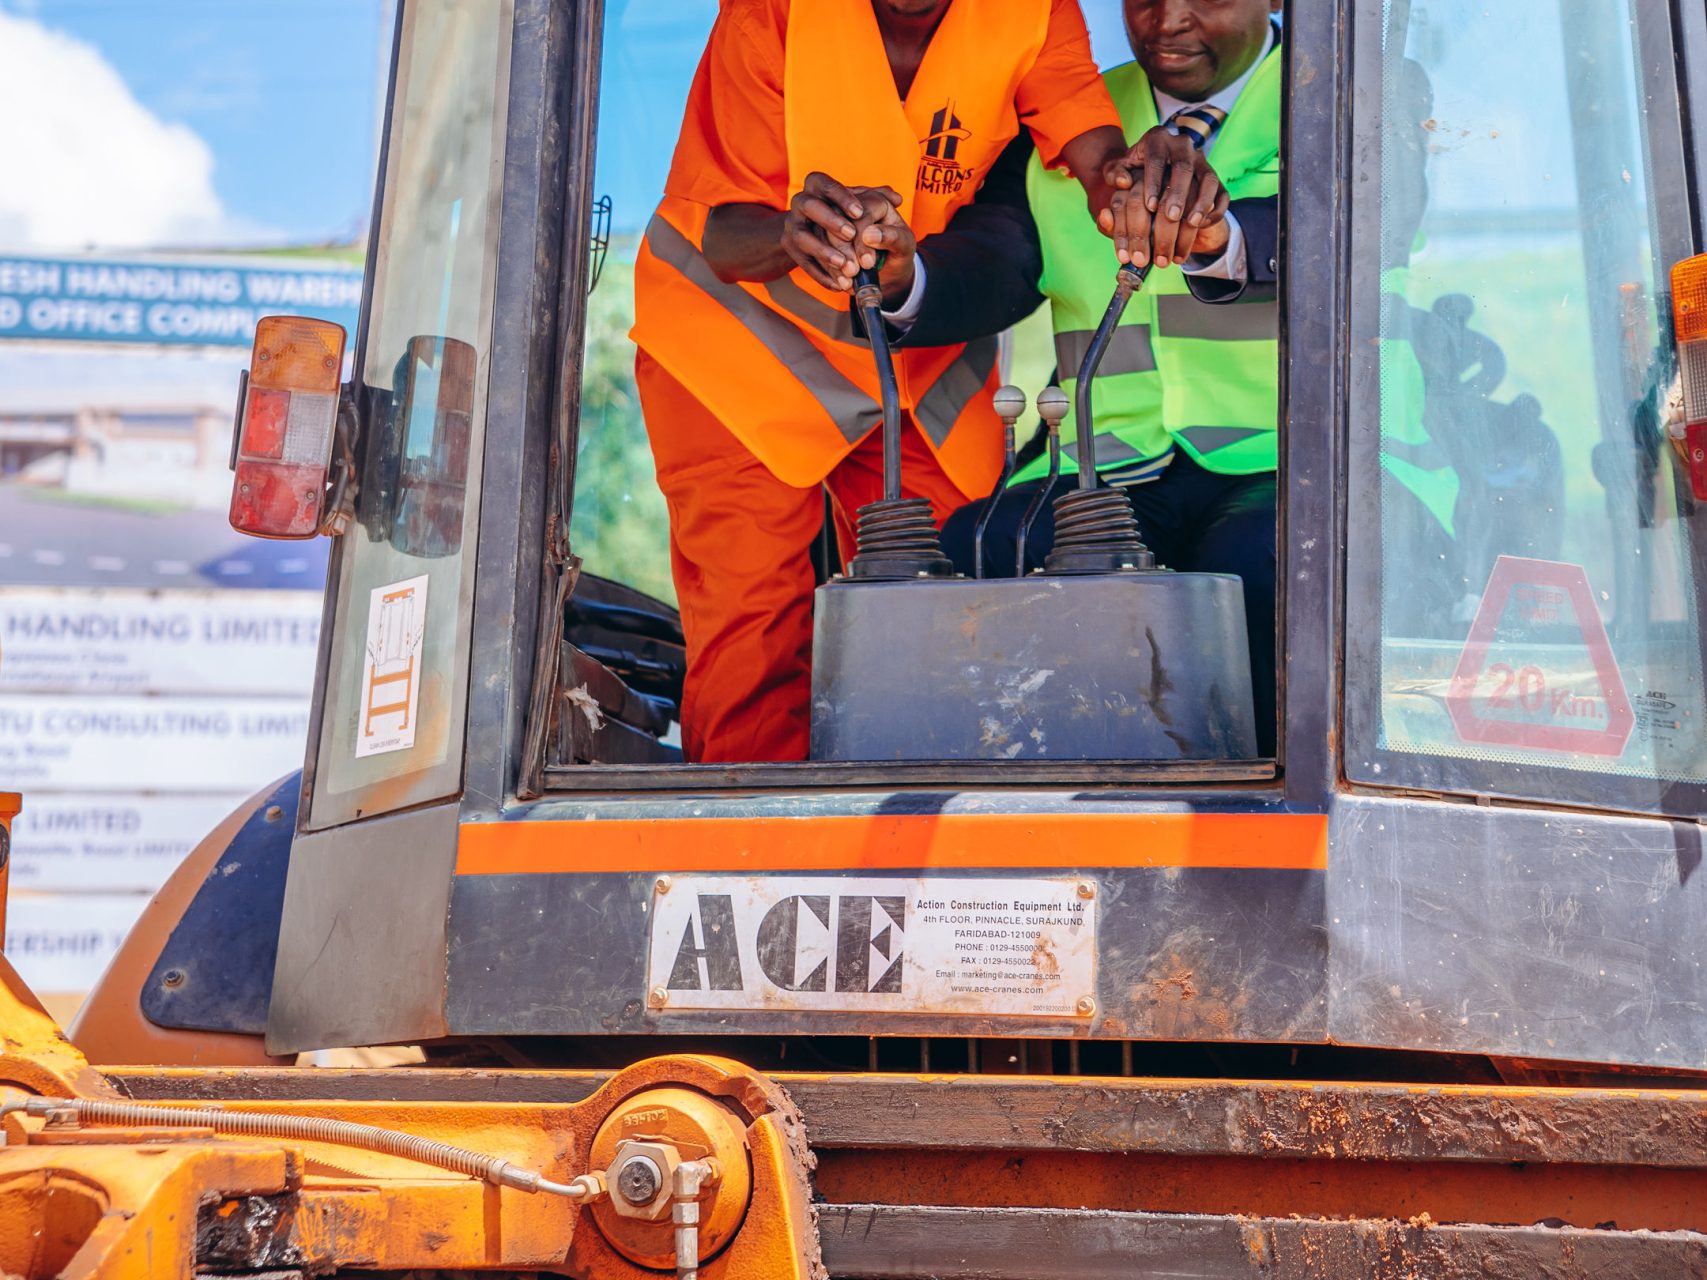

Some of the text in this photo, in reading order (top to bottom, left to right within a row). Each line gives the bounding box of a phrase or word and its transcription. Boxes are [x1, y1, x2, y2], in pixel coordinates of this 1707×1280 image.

[67, 263, 241, 303] HANDLING
[27, 296, 143, 335] OFFICE
[8, 613, 190, 643] HANDLING
[1488, 662, 1545, 713] 20
[44, 709, 231, 737] CONSULTING
[31, 809, 141, 832] LIMITED
[917, 900, 1085, 913] Action Construction Equipment Ltd.
[923, 915, 937, 923] 4th
[940, 915, 972, 925] FLOOR,
[975, 916, 1024, 926] PINNACLE,
[666, 893, 906, 994] ACE
[954, 930, 1041, 939] FARIDABAD-121009
[935, 970, 956, 978] Email
[961, 971, 1061, 981] marketing@ace-cranes.com
[950, 984, 1044, 994] www.ace-cranes.com
